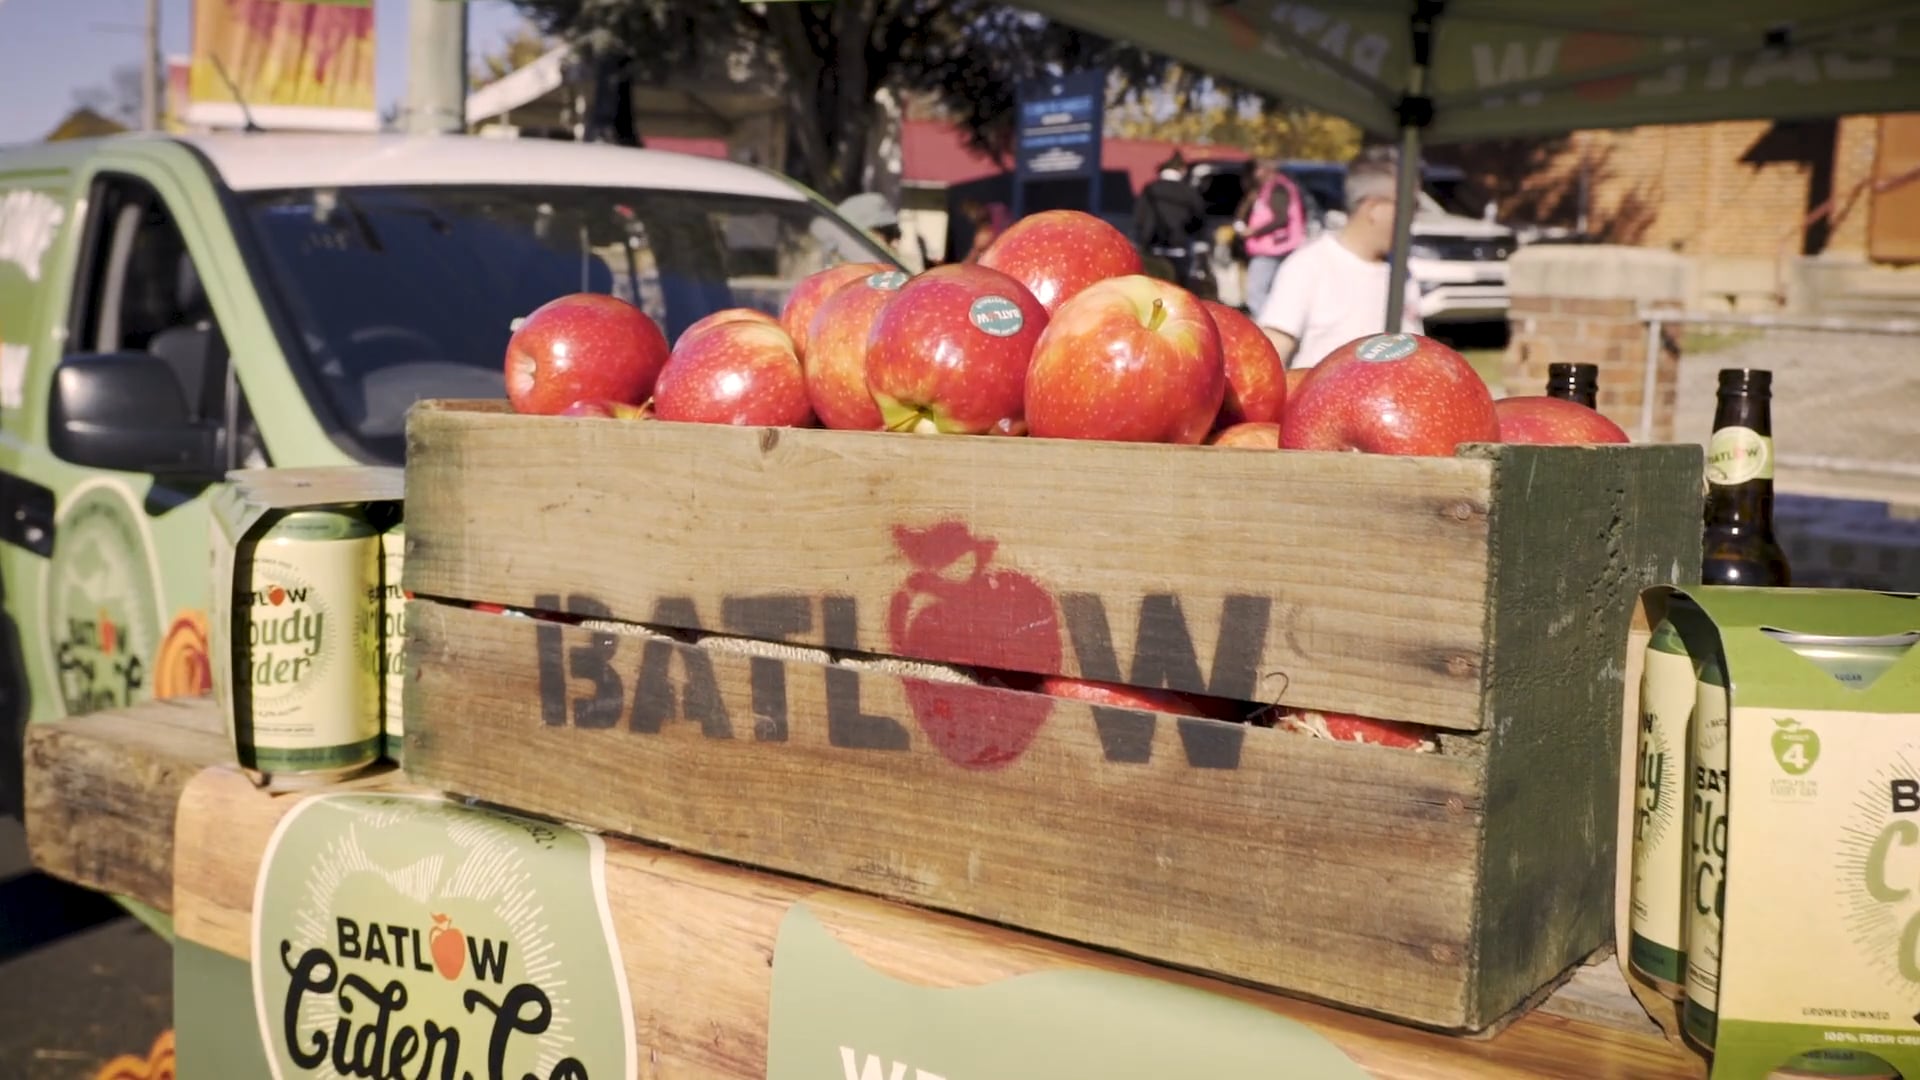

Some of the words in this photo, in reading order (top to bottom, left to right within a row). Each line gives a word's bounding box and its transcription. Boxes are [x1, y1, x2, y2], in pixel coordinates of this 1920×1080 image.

[249, 608, 323, 657] oudy
[533, 592, 1272, 769] BATLOW
[1782, 743, 1810, 770] 4
[336, 914, 509, 984] BATLOW
[280, 939, 460, 1080] Cider
